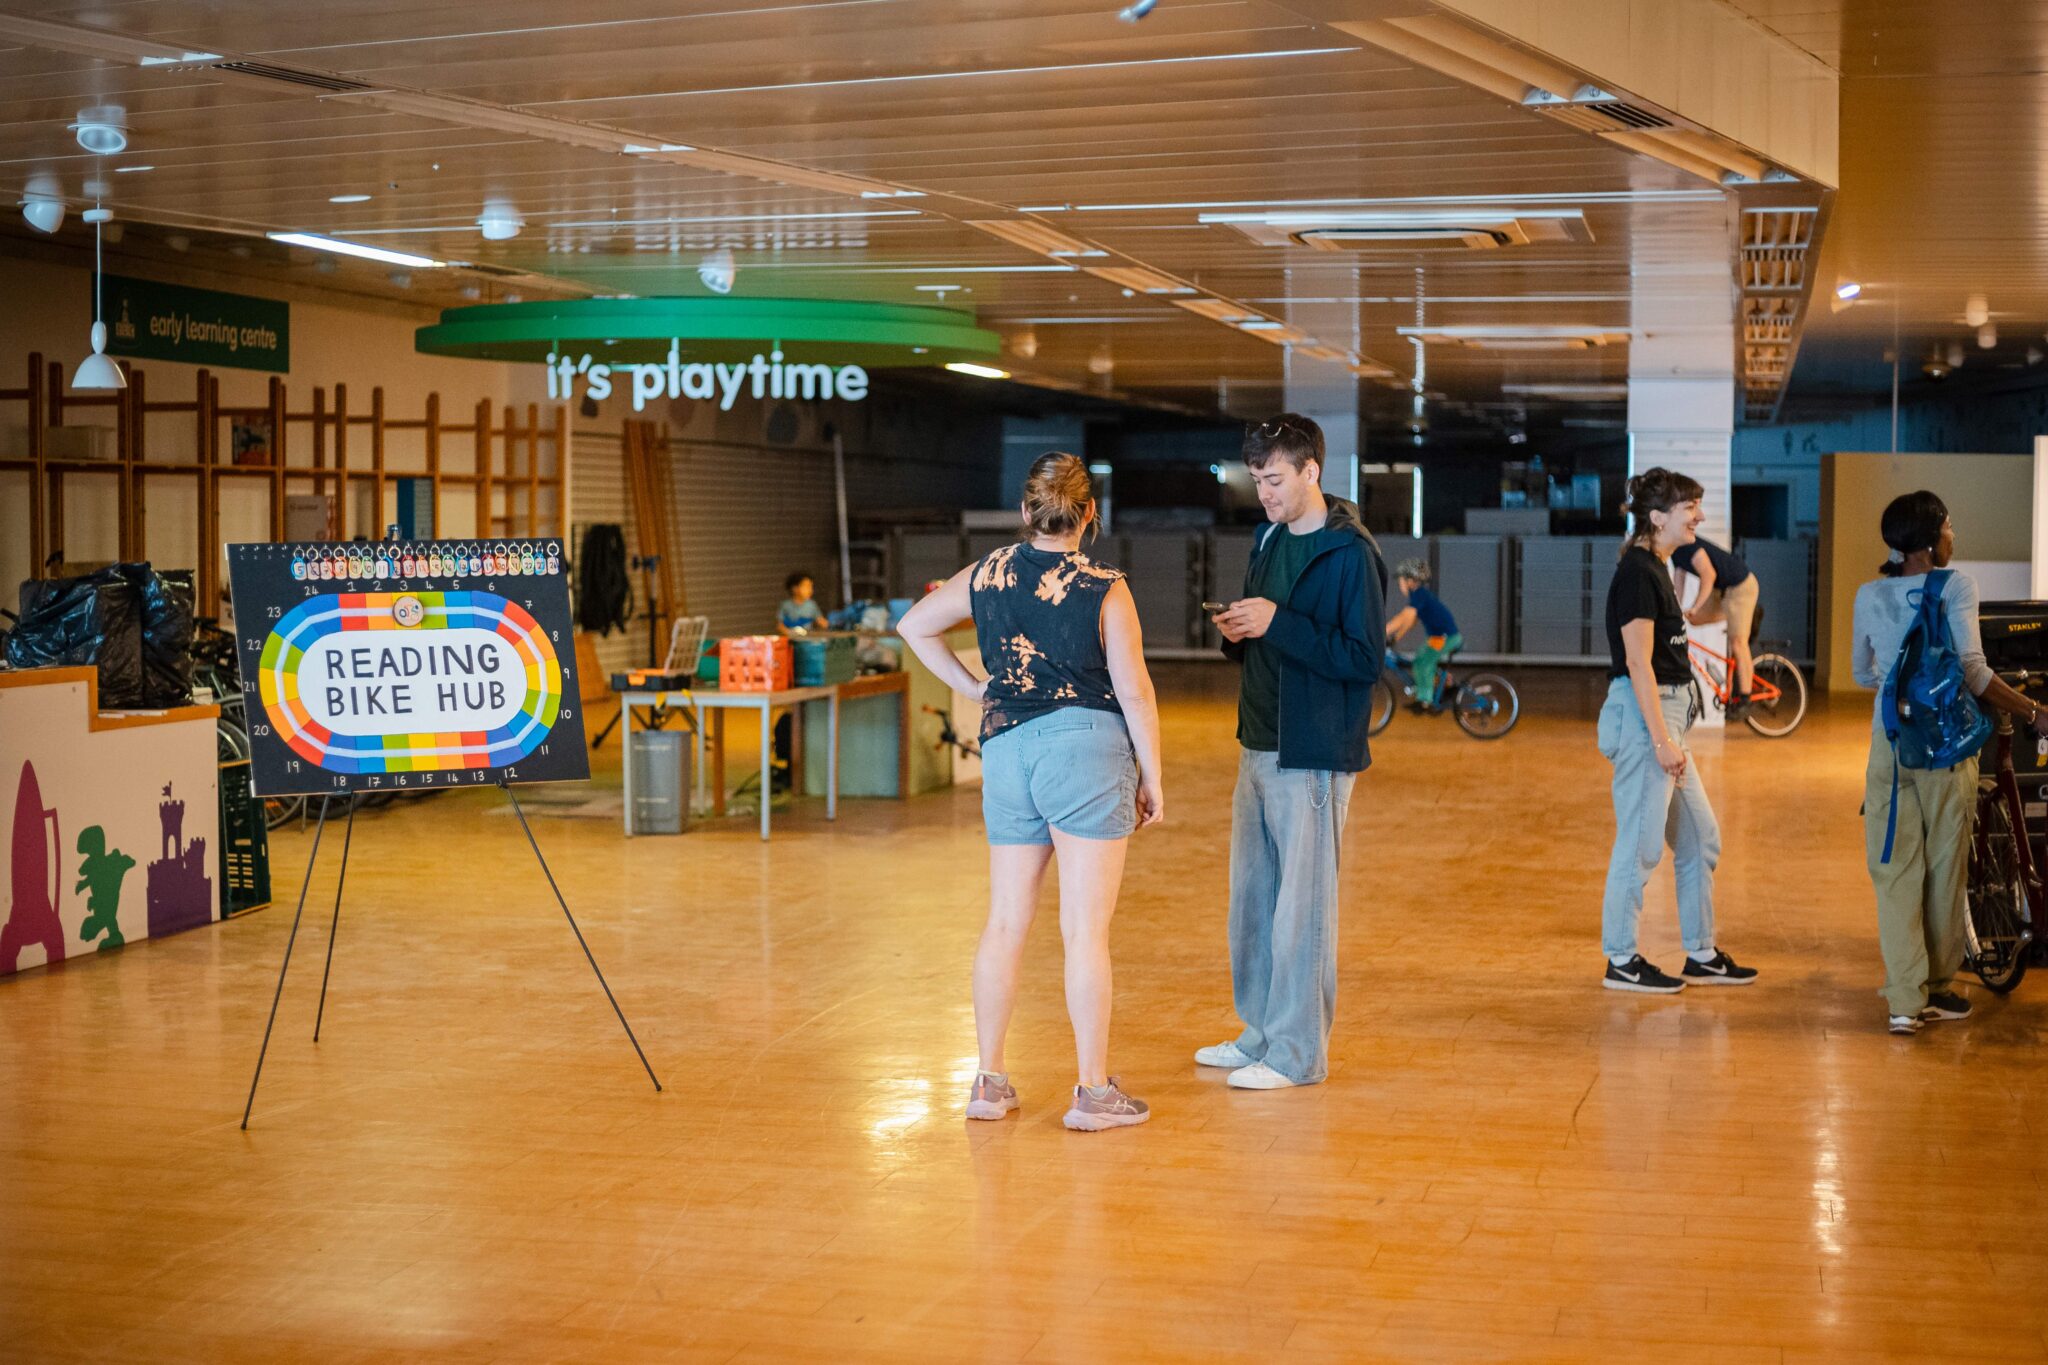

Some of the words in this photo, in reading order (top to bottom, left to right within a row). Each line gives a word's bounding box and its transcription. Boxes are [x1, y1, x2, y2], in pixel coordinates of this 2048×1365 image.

[151, 312, 182, 344] early
[186, 313, 238, 351] learning
[240, 325, 277, 350] centre
[546, 351, 612, 400] it's
[632, 347, 869, 412] playtime
[304, 585, 319, 595] 24
[347, 581, 357, 592] 1
[372, 580, 383, 591] 2
[400, 580, 408, 591] 3
[425, 581, 434, 590] 4
[453, 579, 460, 590] 5
[489, 582, 495, 591] 6
[525, 600, 533, 609] 7
[267, 606, 282, 618] 23
[2008, 622, 2041, 632] STANLEY
[552, 630, 559, 642] 8
[246, 639, 261, 651] 22
[325, 643, 500, 680] READING
[563, 667, 570, 679] 9
[244, 681, 256, 692] 21
[326, 684, 413, 717] BIKE
[437, 681, 506, 712] HUB
[560, 709, 572, 719] 10
[253, 724, 269, 736] 20
[540, 745, 549, 755] 11
[287, 760, 300, 773] 19
[447, 773, 459, 783] 14
[473, 771, 485, 781] 13
[504, 767, 518, 778] 12
[333, 776, 347, 787] 18
[368, 776, 381, 787] 17
[394, 775, 407, 785] 16
[422, 774, 433, 783] 15
